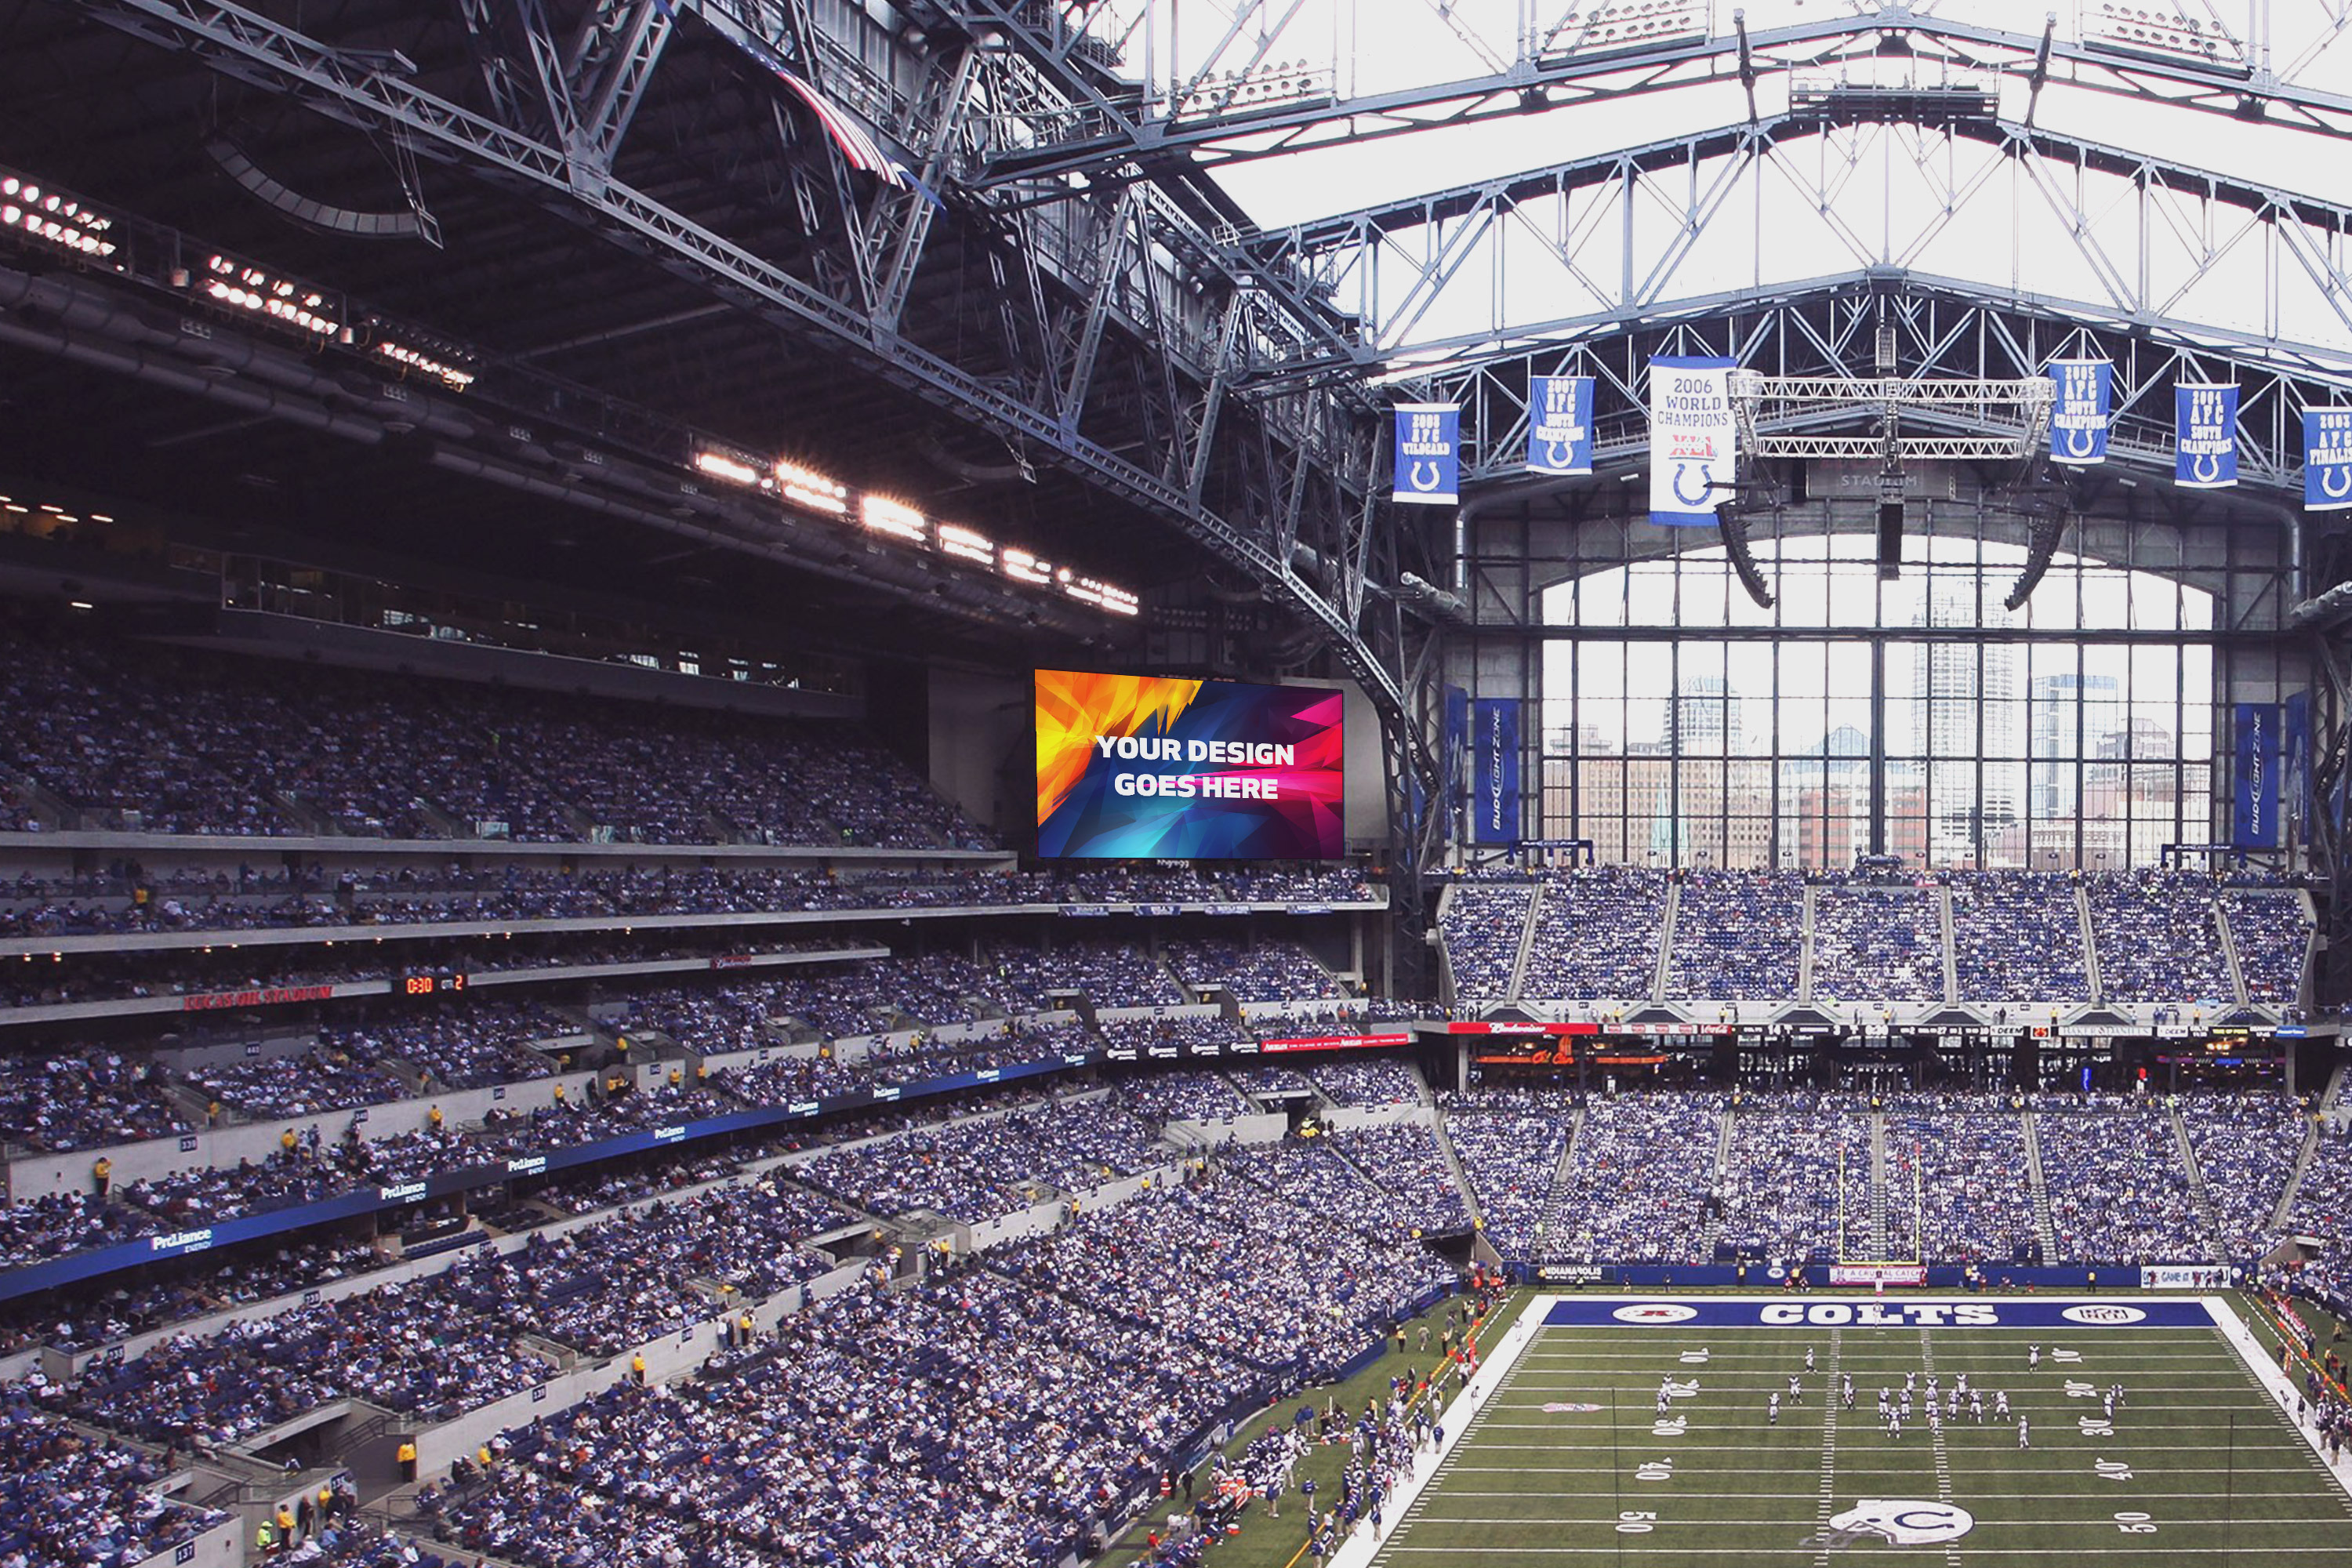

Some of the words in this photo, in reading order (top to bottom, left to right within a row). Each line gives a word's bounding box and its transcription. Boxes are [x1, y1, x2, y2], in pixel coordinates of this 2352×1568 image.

[2065, 365, 2096, 380] 2005
[1547, 379, 1577, 394] 2007
[1674, 378, 1712, 394] 2006
[2064, 380, 2096, 400] AFC
[1546, 393, 1576, 413] AFC
[1666, 395, 1721, 410] WORLD
[2192, 390, 2222, 405] 2004
[2064, 400, 2096, 416] SOUTH
[2190, 405, 2223, 425] AFC
[1657, 411, 1728, 427] CHAMPIONS
[2054, 412, 2107, 430] CHAMPIONS
[2320, 414, 2350, 429] 2003
[2191, 425, 2222, 440] SOUTH
[2319, 430, 2352, 448] AFC
[2181, 437, 2233, 455] CHAMPIONS
[1492, 706, 1501, 748] ZONE
[2252, 712, 2261, 753] ZONE
[1095, 735, 1181, 761] YOUR
[1188, 739, 1294, 765] DESIGN
[1114, 773, 1196, 797] GOES
[1203, 776, 1279, 800] HERE
[2252, 754, 2260, 802] LIGHT
[1492, 800, 1501, 830] BUD
[407, 978, 433, 993] 0:30
[456, 975, 463, 990] 2
[184, 993, 232, 1011] LUCAS
[236, 991, 261, 1006] OIL
[264, 985, 333, 1004] STADIUM
[1769, 1025, 1780, 1035] 14
[1833, 1025, 1841, 1036] 3
[508, 1156, 546, 1172] ProLiance
[381, 1182, 426, 1200] ProLiance
[152, 1229, 212, 1250] ProLiance
[1760, 1304, 1999, 1325] COLTS
[1679, 1350, 1708, 1363] 10
[2051, 1350, 2083, 1363] 10
[1670, 1382, 1700, 1396] 20
[2063, 1382, 2098, 1396] 20
[1652, 1419, 1687, 1436] 30
[2078, 1419, 2114, 1436] 30
[1635, 1461, 1673, 1480] 40
[2095, 1462, 2133, 1480] 40
[1615, 1511, 1657, 1533] 50
[2114, 1512, 2158, 1534] 50
[178, 1546, 193, 1561] 137
